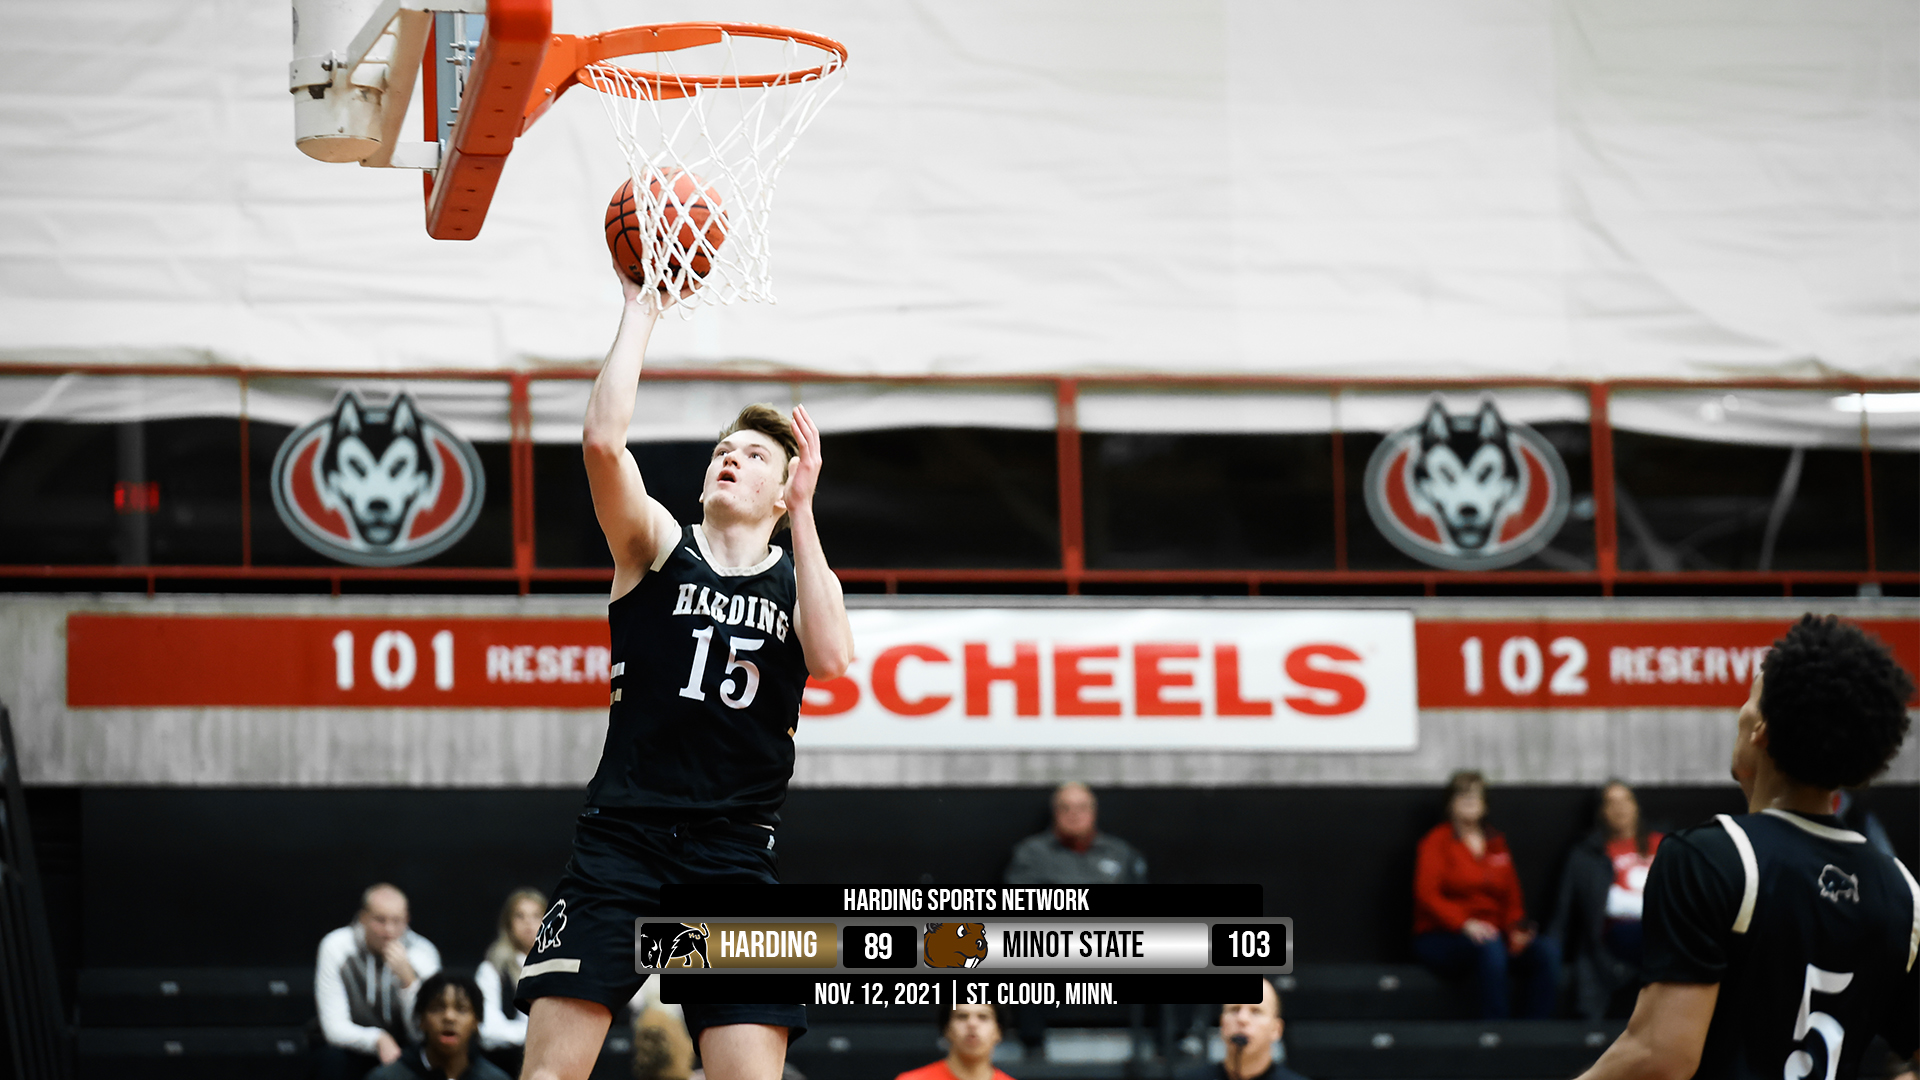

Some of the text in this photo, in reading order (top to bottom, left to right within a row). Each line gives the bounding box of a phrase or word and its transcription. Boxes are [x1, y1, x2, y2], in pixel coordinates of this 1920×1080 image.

[673, 583, 789, 643] HARDING
[333, 629, 455, 691] 101
[678, 625, 765, 710] 15
[1460, 635, 1589, 695] 102
[1784, 963, 1854, 1080] 5
